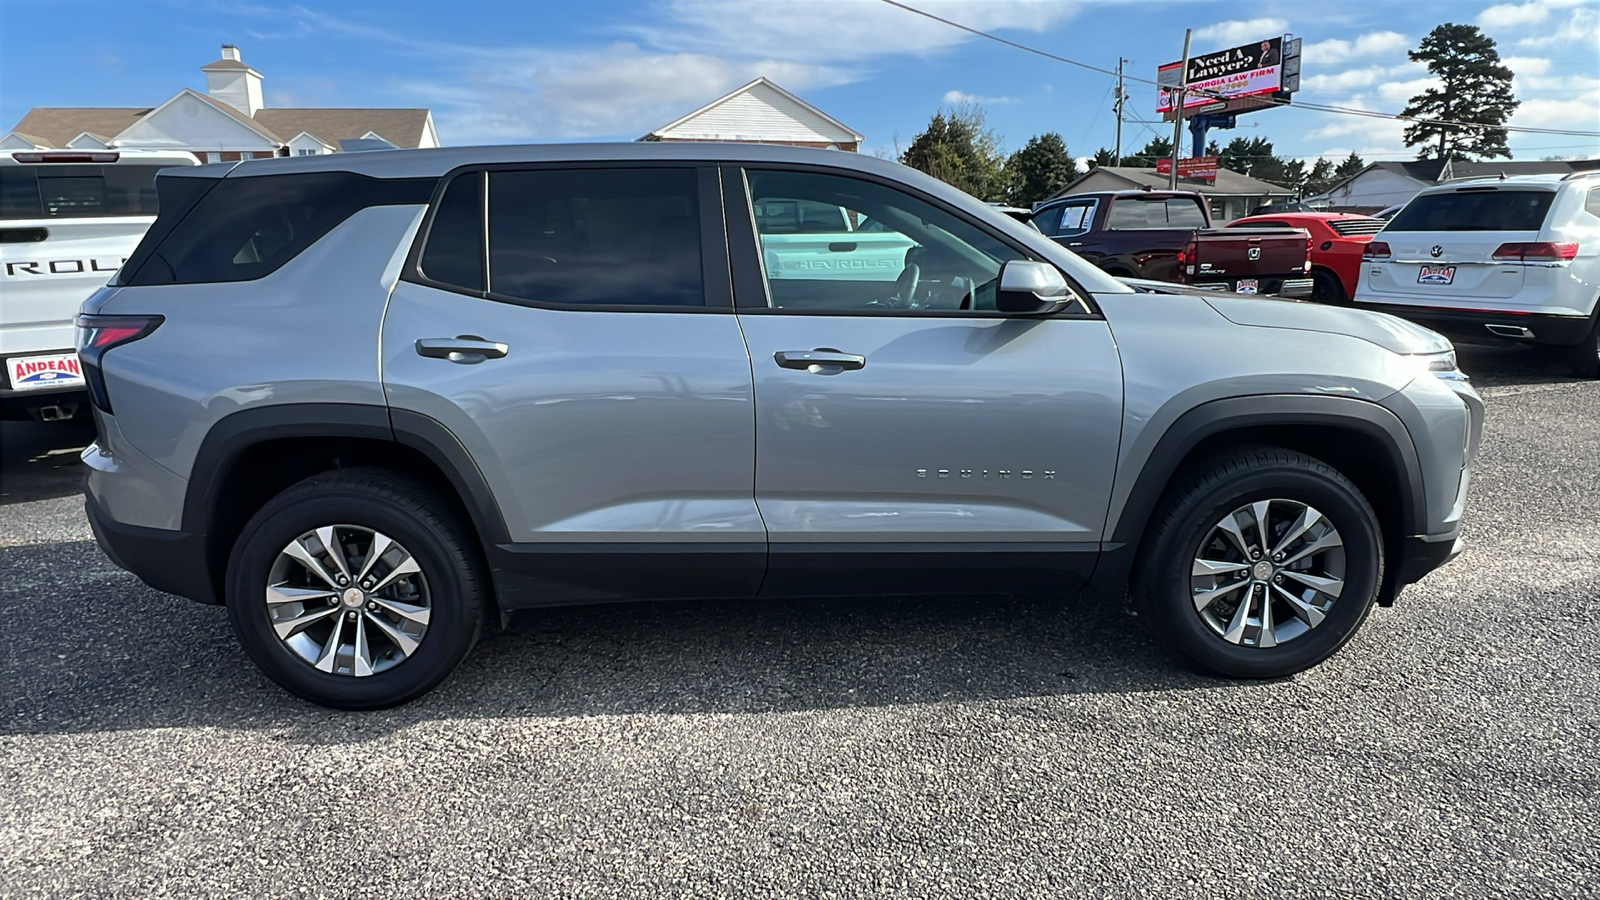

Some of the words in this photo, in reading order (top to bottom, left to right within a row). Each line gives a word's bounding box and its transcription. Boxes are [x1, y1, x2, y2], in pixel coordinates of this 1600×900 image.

[1188, 55, 1254, 80] Lawyer?
[1194, 51, 1230, 70] Need
[1233, 48, 1245, 62] A
[1228, 73, 1248, 82] LAW
[1250, 68, 1275, 78] FIRM
[6, 258, 127, 276] ROL
[16, 359, 80, 380] ANDEAN
